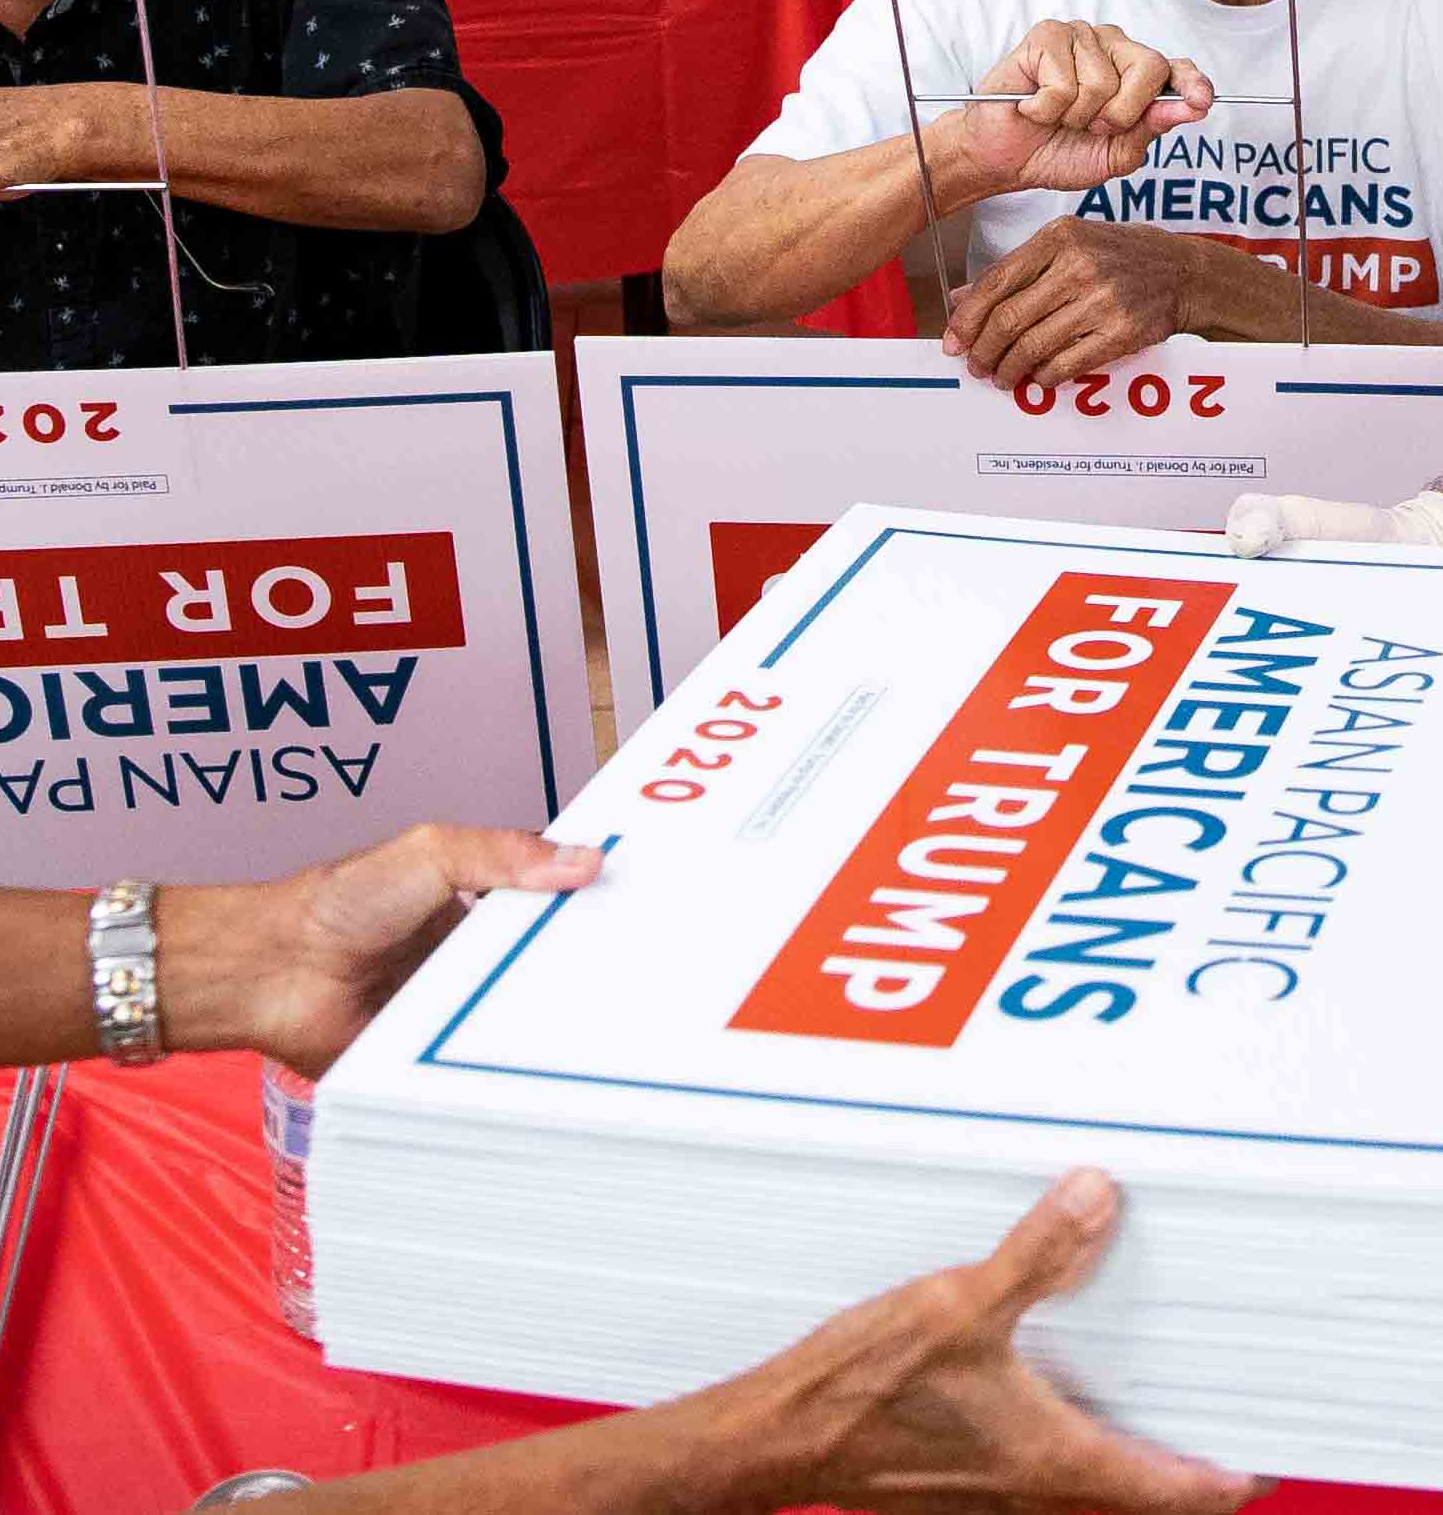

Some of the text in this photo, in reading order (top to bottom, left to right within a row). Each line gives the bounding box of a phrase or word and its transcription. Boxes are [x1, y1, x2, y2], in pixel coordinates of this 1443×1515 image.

[1235, 138, 1391, 176] PACIFIC
[1075, 179, 1414, 228] AMERICANS
[1013, 373, 1226, 418] 2020
[1013, 459, 1072, 471] President,
[1074, 461, 1092, 472] for
[1094, 459, 1132, 472] Trump
[1147, 462, 1189, 473] Donald
[1191, 460, 1206, 473] by
[1209, 462, 1227, 474] for
[1229, 462, 1254, 473] Paid
[0, 482, 36, 495] Trump
[50, 482, 92, 494] Donald
[94, 480, 109, 493] by
[132, 480, 157, 491] Paid
[158, 562, 412, 633] FOR
[640, 690, 783, 803] 2020
[123, 742, 382, 810] ASIAN
[819, 593, 1184, 1012] FOR TRUMP
[997, 605, 1336, 1025] AMERICANS
[1185, 787, 1382, 1002] PACIFIC
